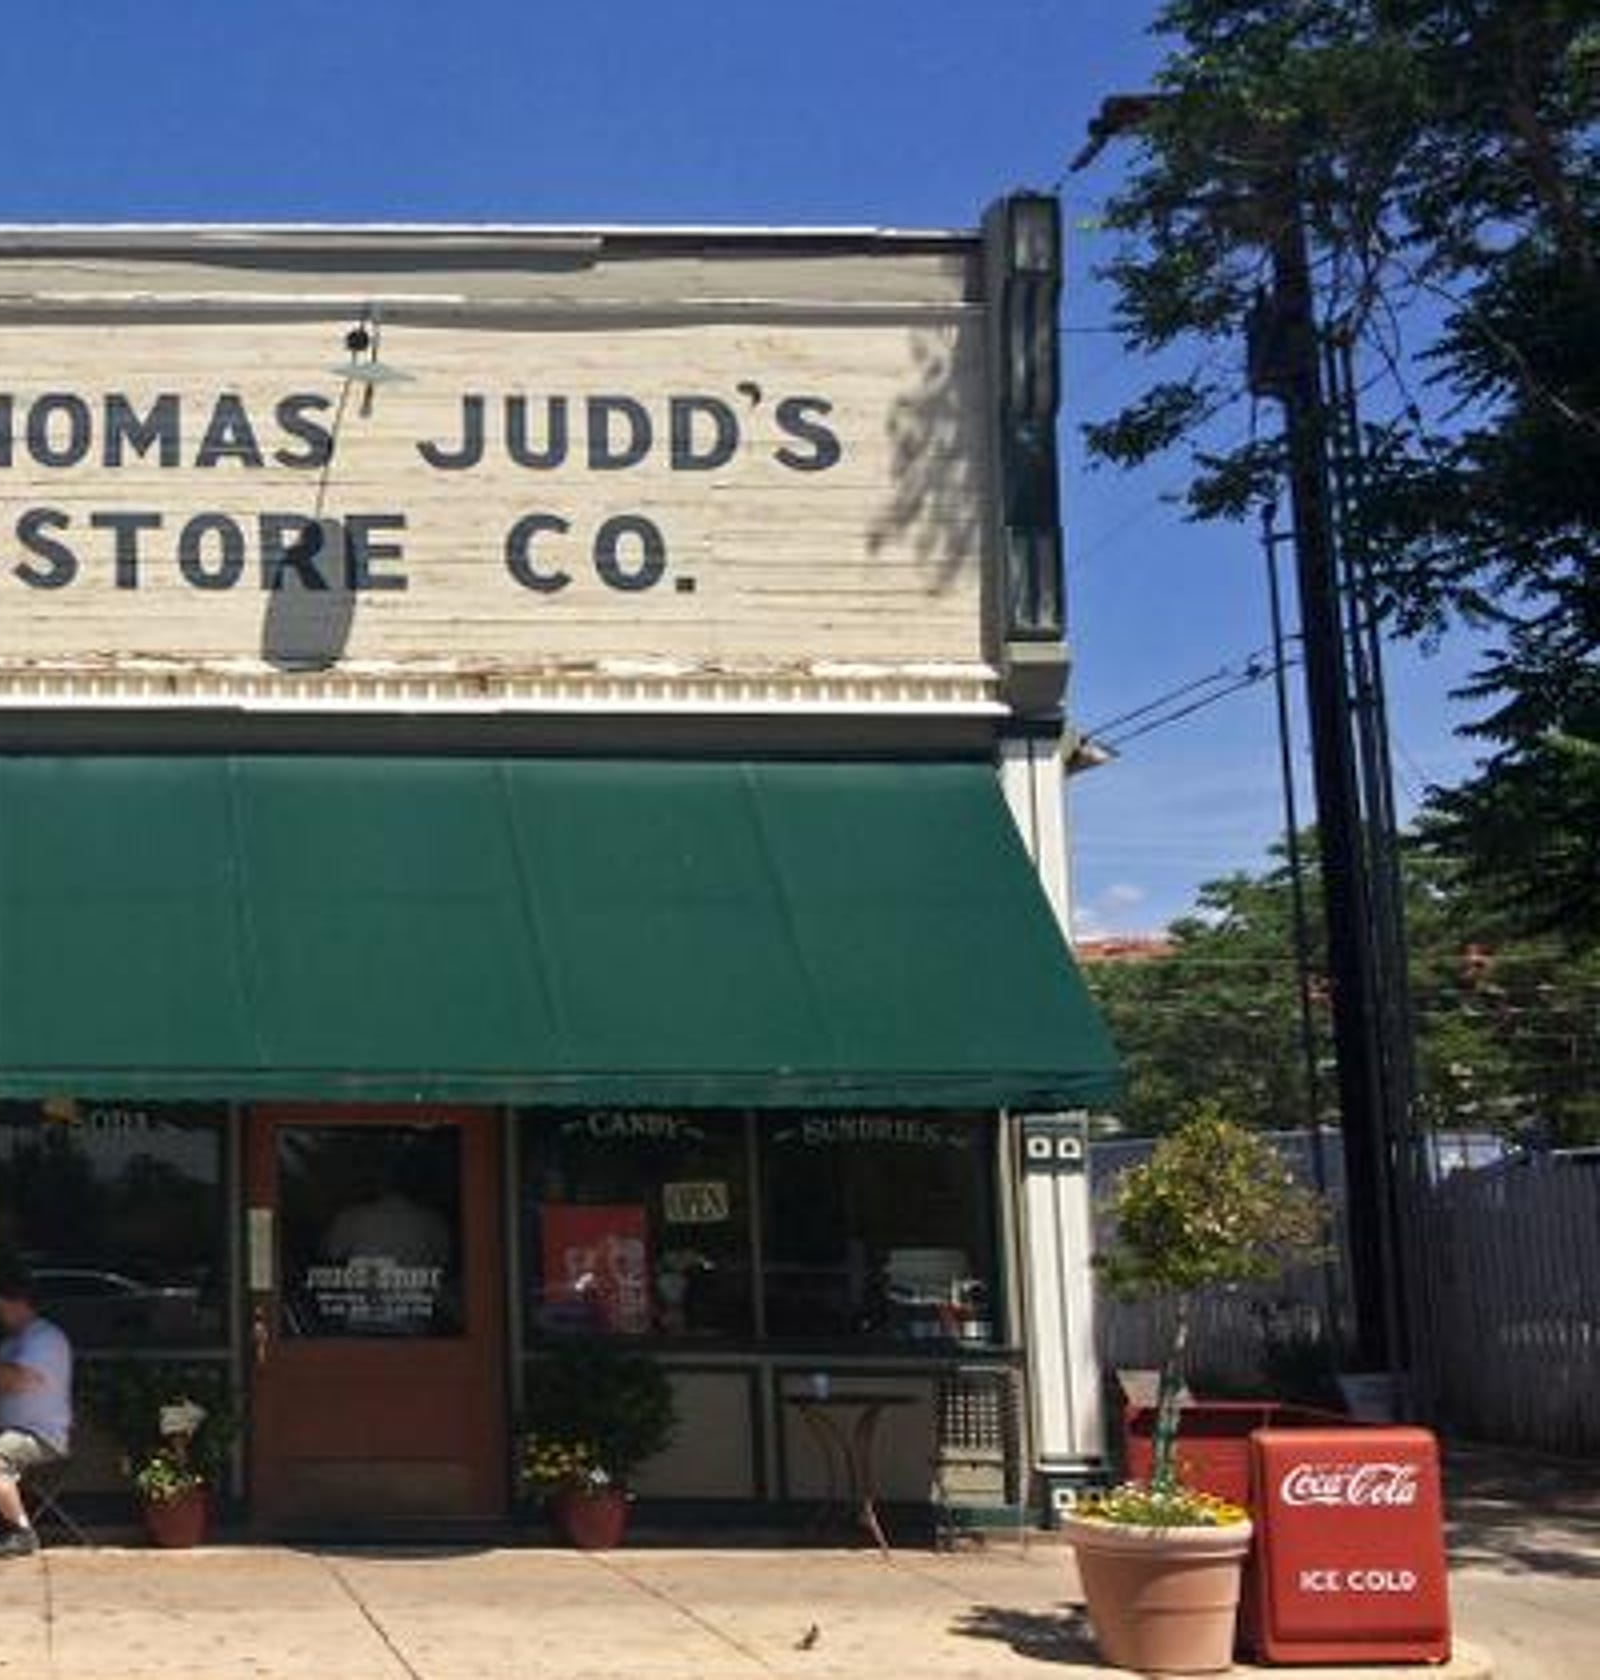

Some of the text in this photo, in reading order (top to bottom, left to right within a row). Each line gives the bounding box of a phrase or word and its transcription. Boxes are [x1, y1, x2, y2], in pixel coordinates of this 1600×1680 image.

[416, 380, 843, 472] JUDD'S
[11, 508, 697, 594] STORE CO.
[587, 1112, 681, 1139] CANDY
[802, 1114, 942, 1144] SUNDRIES
[1280, 1462, 1418, 1506] Coca-Cola
[1300, 1569, 1418, 1593] ICE COLD
